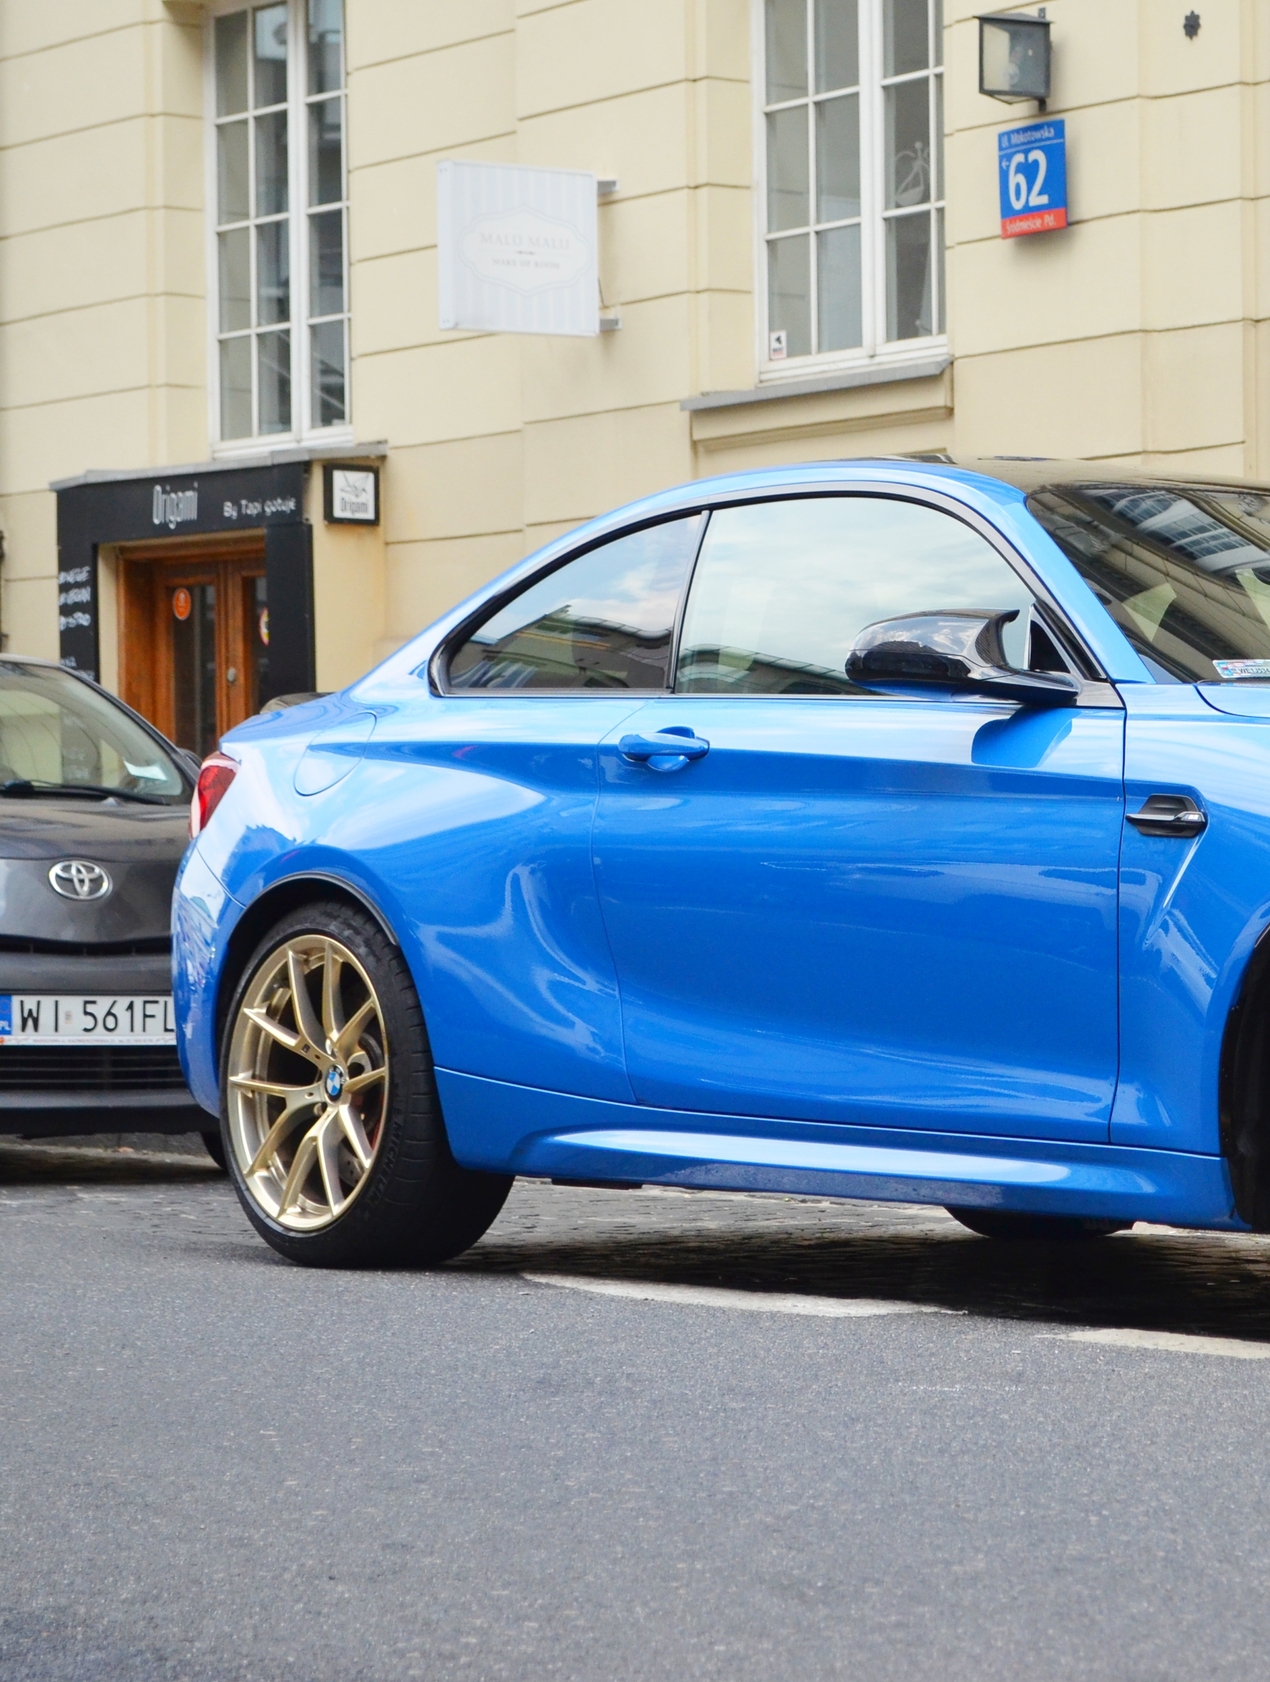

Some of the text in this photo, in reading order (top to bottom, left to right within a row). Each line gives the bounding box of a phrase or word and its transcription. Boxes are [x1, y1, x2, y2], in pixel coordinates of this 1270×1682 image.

[1008, 149, 1049, 210] 62
[152, 481, 199, 529] Origami
[82, 1000, 175, 1033] 561FL
